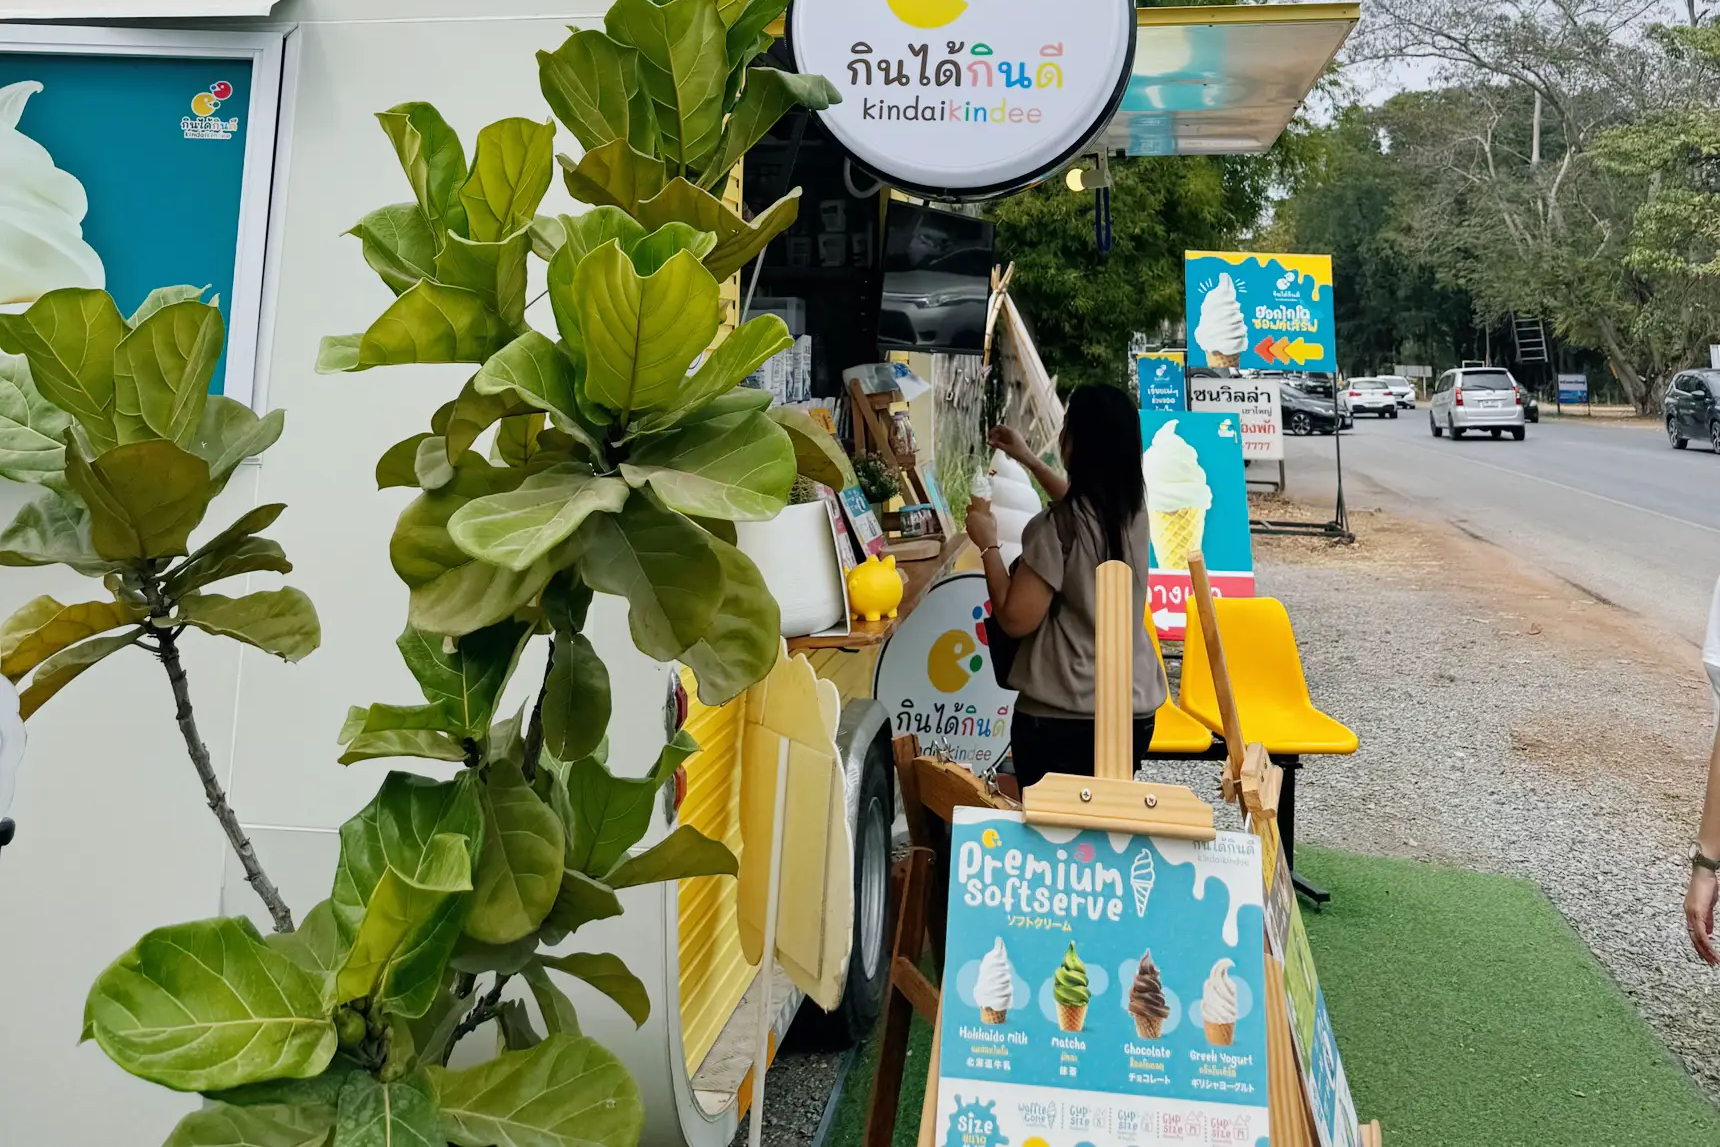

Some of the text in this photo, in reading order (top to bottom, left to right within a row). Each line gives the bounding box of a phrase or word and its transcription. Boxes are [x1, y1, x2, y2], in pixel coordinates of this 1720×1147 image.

[846, 40, 1064, 90] กินได้กินดี
[862, 95, 1043, 124] kindaikindee
[1190, 385, 1272, 404] ซนวิลล่า
[896, 698, 1009, 738] กินได้กินดี
[958, 840, 1124, 897] Premium
[1007, 915, 1073, 932] ソフトクリーム
[1124, 1042, 1171, 1058] Chocolate
[1190, 1049, 1218, 1062] Greek
[1128, 1072, 1171, 1085] チョコレート
